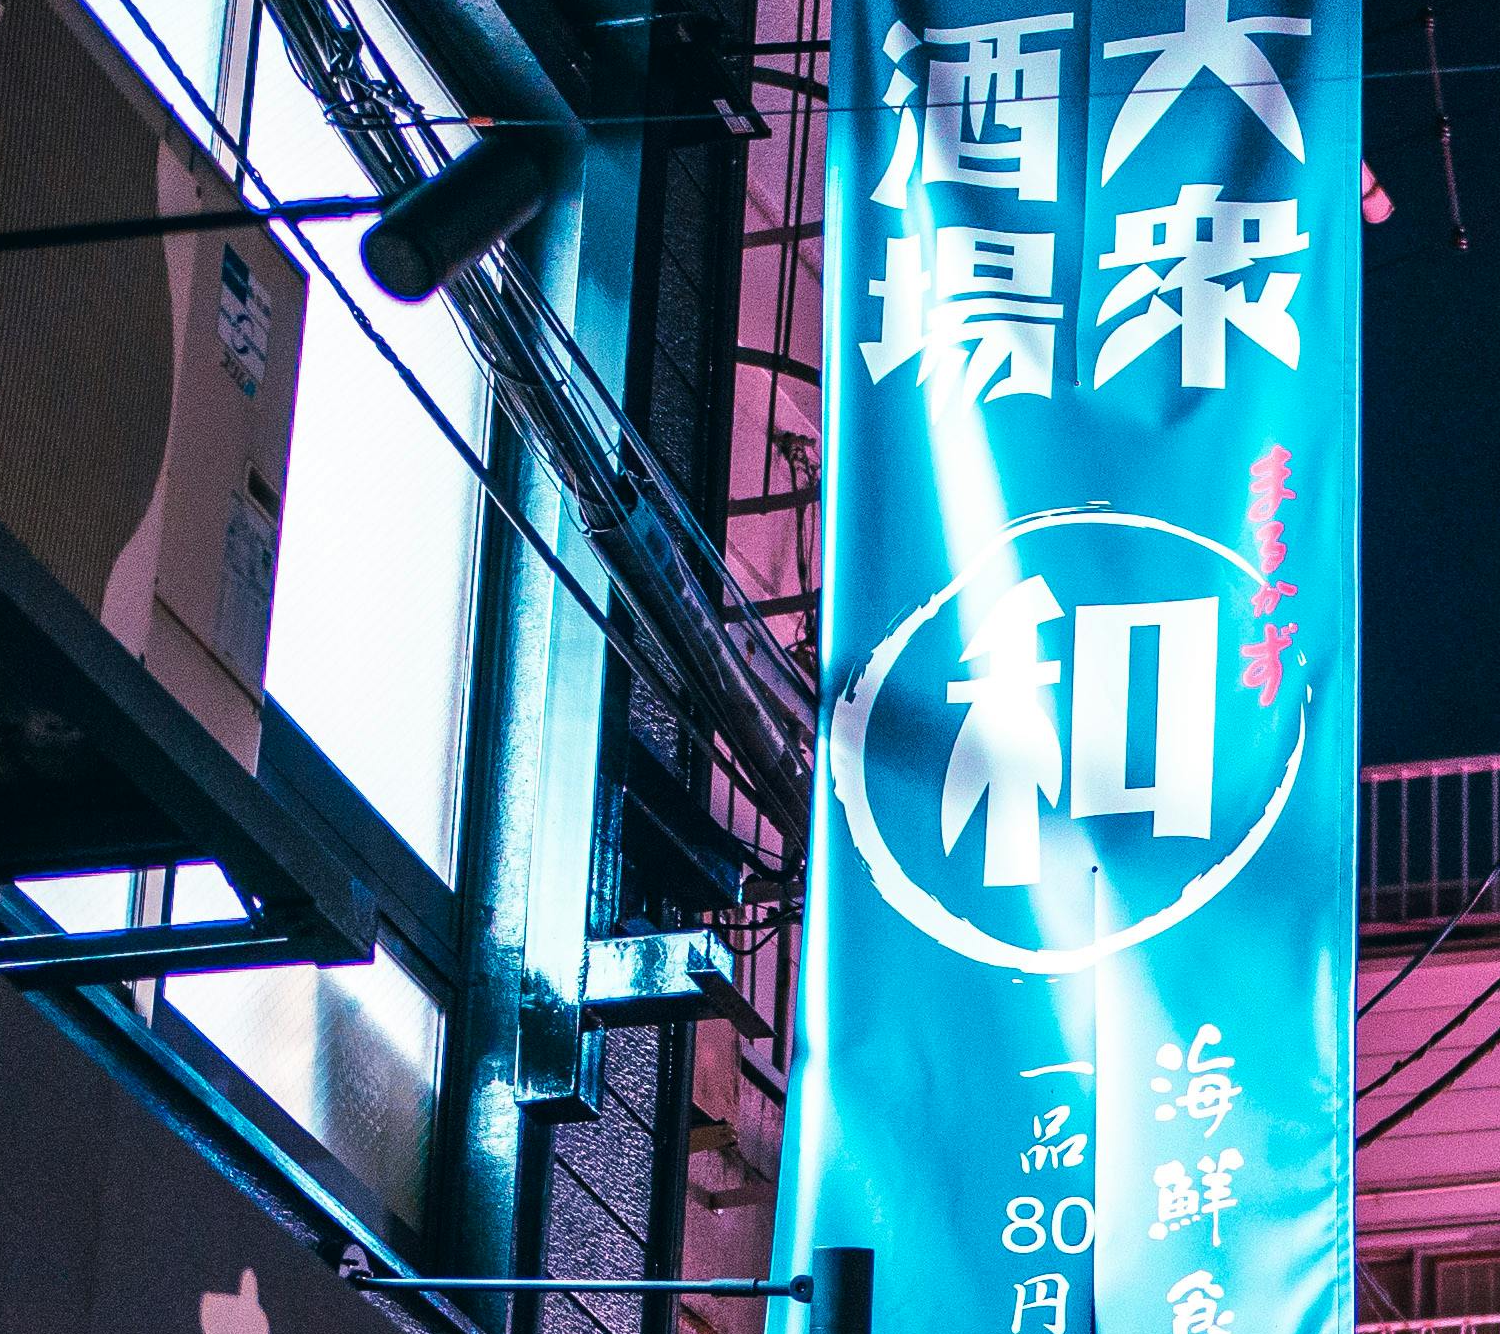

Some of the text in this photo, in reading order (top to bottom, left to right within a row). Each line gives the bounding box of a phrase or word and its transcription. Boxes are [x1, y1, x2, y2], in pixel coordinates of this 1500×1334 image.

[1241, 443, 1298, 708] まるかず
[939, 574, 1219, 887] 和
